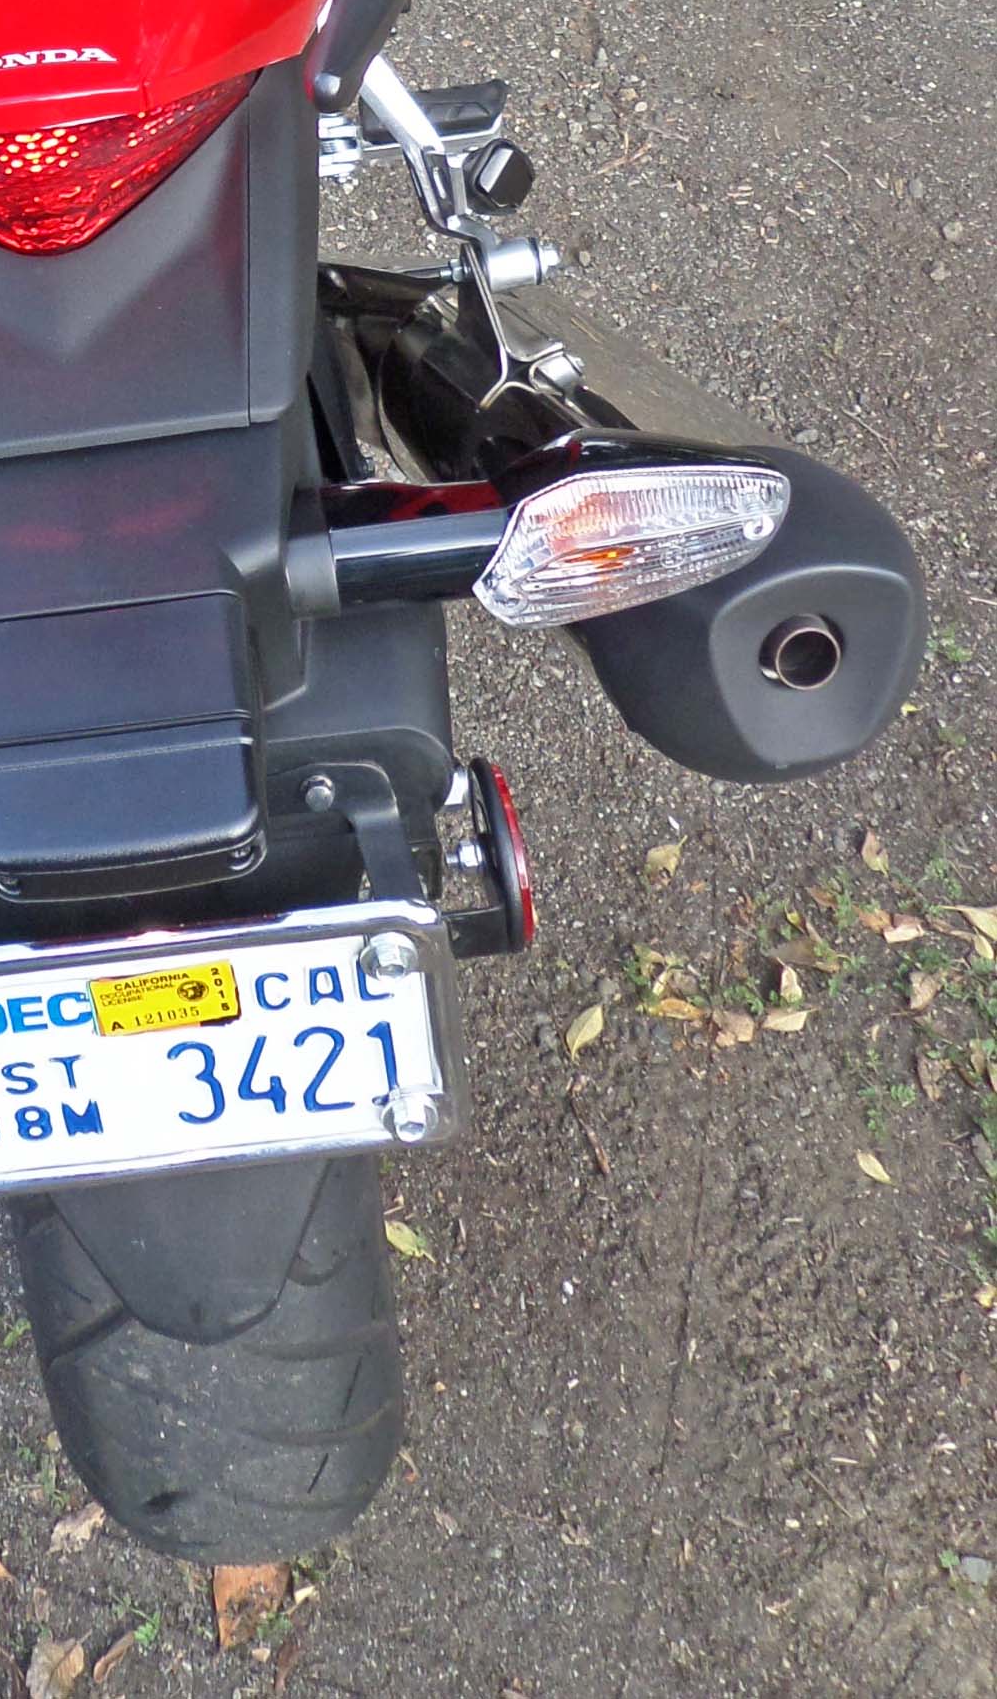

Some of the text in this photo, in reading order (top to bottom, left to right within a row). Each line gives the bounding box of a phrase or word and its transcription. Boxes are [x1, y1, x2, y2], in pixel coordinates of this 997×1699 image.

[100, 983, 175, 1000] OCCUPATIONAL
[114, 973, 190, 991] CALIFORNIA
[210, 967, 230, 1011] 2015
[255, 960, 394, 1010] CAL
[102, 995, 144, 1007] LICENSE
[111, 1006, 200, 1032] A 121035
[166, 1021, 400, 1125] 3421
